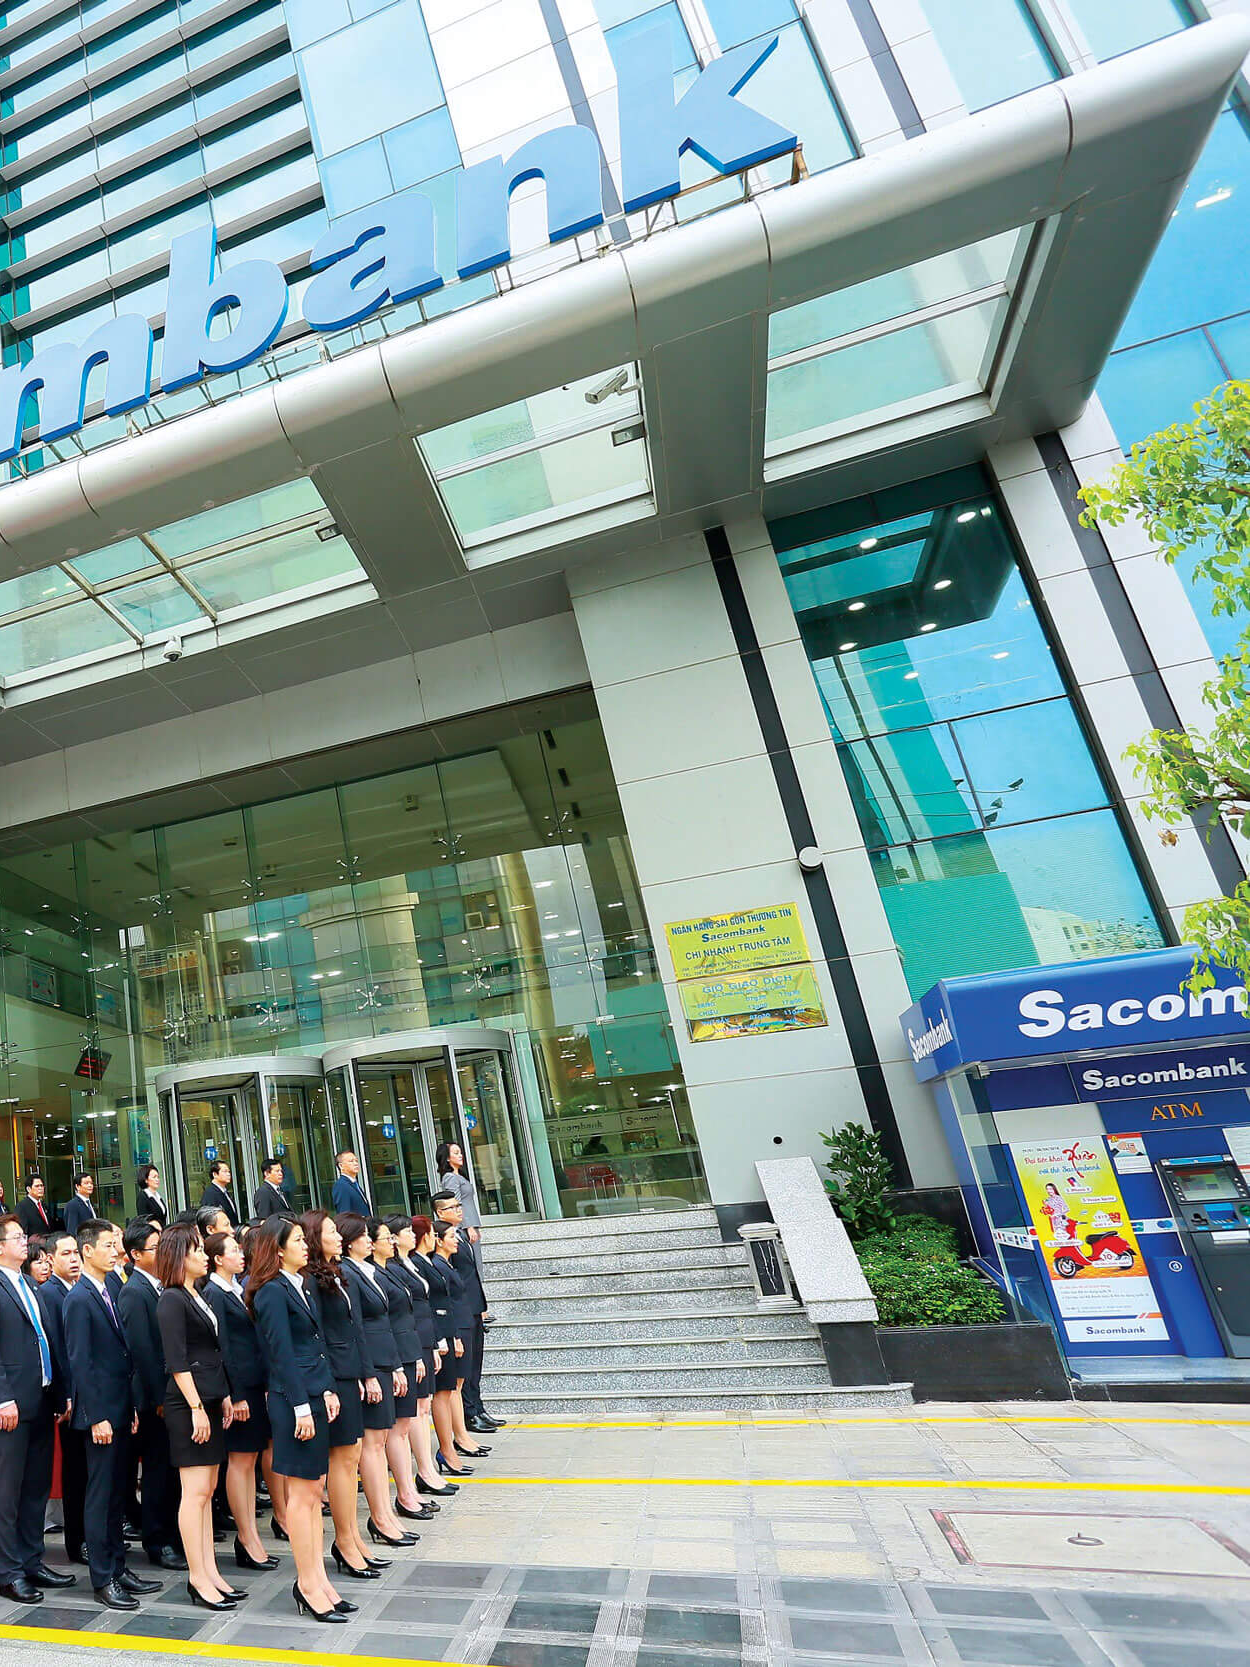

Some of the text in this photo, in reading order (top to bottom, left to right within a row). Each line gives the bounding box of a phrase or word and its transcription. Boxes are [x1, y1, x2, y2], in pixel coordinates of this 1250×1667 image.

[701, 924, 766, 943] Sacombank
[685, 951, 702, 960] CHI
[738, 940, 770, 952] TRUNG
[729, 979, 758, 990] GIAO
[907, 1009, 953, 1063] Sacombank
[1082, 1057, 1247, 1091] Sacombank
[1151, 1101, 1204, 1121] ATM
[1086, 1325, 1146, 1335] Sacombank
